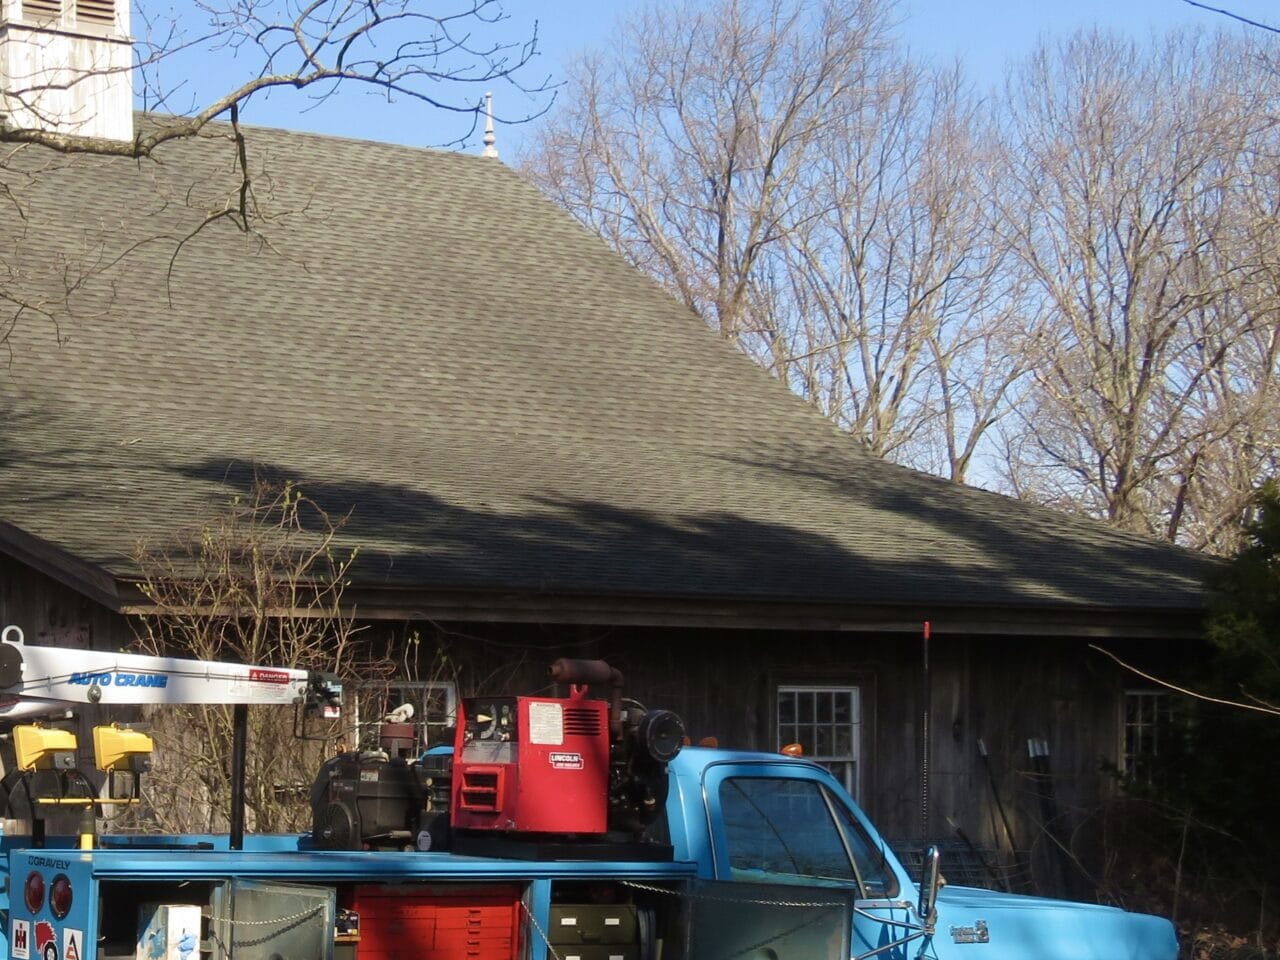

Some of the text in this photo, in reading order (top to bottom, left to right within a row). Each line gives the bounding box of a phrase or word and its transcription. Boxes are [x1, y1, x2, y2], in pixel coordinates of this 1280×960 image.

[67, 672, 169, 689] AUTO CRANE
[551, 754, 579, 762] LINCOLN
